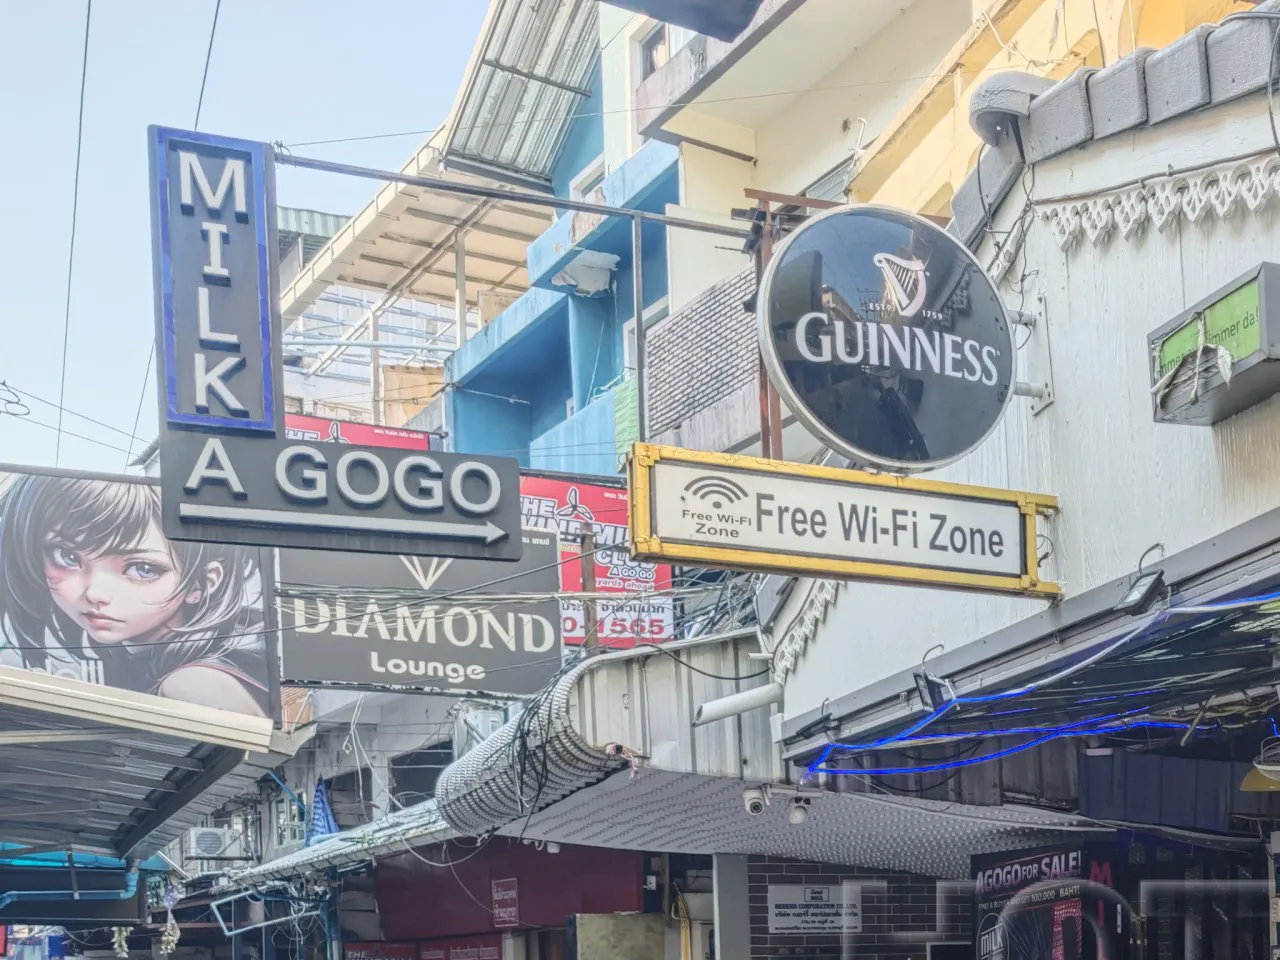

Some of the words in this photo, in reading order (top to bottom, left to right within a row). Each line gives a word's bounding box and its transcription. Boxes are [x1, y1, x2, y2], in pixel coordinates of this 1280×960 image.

[178, 150, 249, 418] MILK
[922, 310, 943, 321] 1759
[1243, 305, 1259, 329] da!
[795, 312, 998, 387] GUINNESS
[185, 437, 247, 499] A
[275, 444, 501, 516] GOGO
[682, 509, 713, 523] Free
[717, 514, 752, 527] Wi-Fi
[695, 523, 740, 539] Zone
[756, 492, 827, 539] Free
[838, 502, 919, 549] Wi-Fi
[929, 513, 1004, 558] Zone
[596, 579, 622, 590] yards
[293, 598, 555, 653] DIAMOND
[370, 651, 486, 683] Lounge
[975, 863, 1022, 894] AGOGO
[1022, 863, 1039, 881] FOR
[1041, 850, 1081, 880] SALE!
[1059, 884, 1080, 897] BAHT!
[347, 951, 367, 959] THE
[980, 926, 1004, 956] MILK
